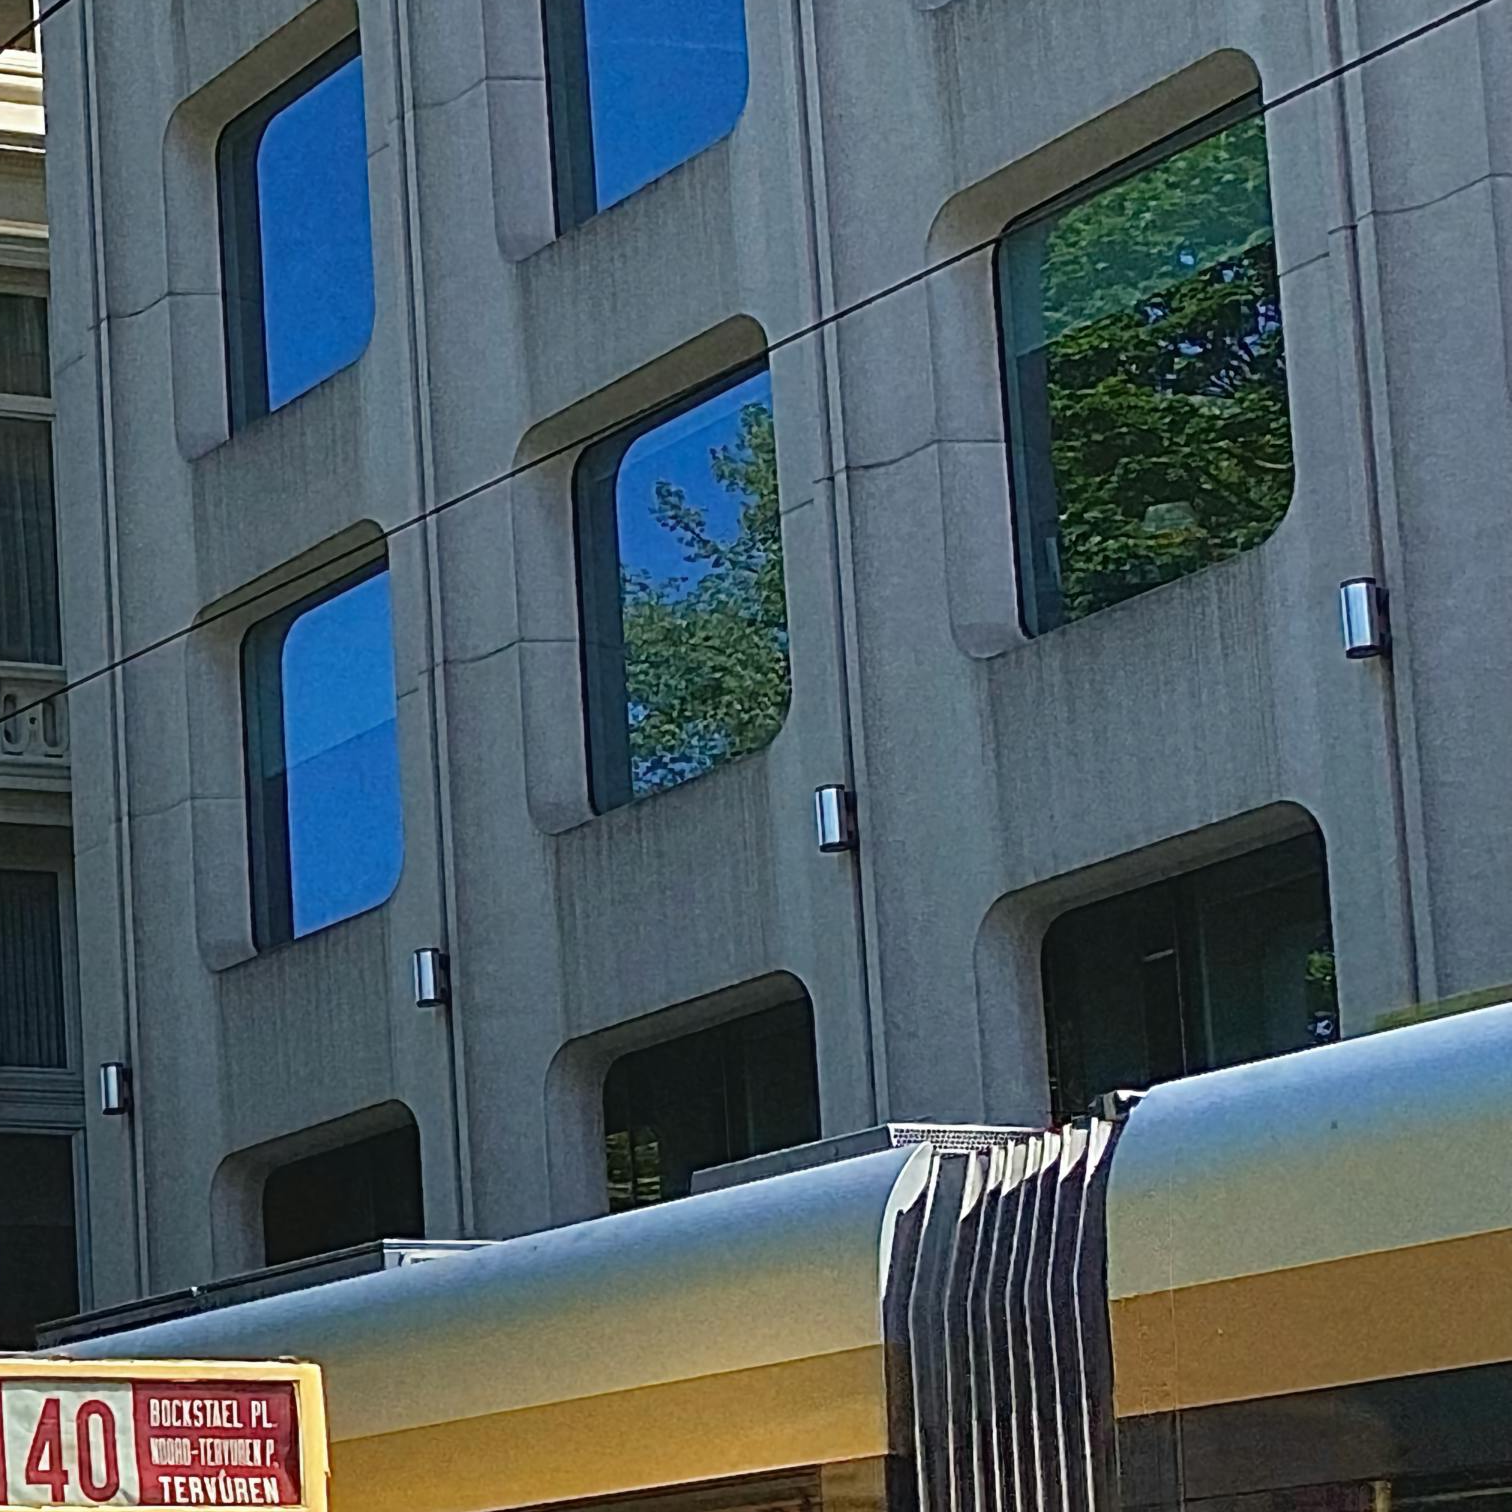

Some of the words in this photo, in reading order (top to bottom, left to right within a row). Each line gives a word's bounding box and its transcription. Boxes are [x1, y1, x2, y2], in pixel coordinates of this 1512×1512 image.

[149, 1398, 244, 1428] BOCKSTAEL
[25, 1398, 120, 1503] 40
[158, 1474, 281, 1504] TERVUREN
